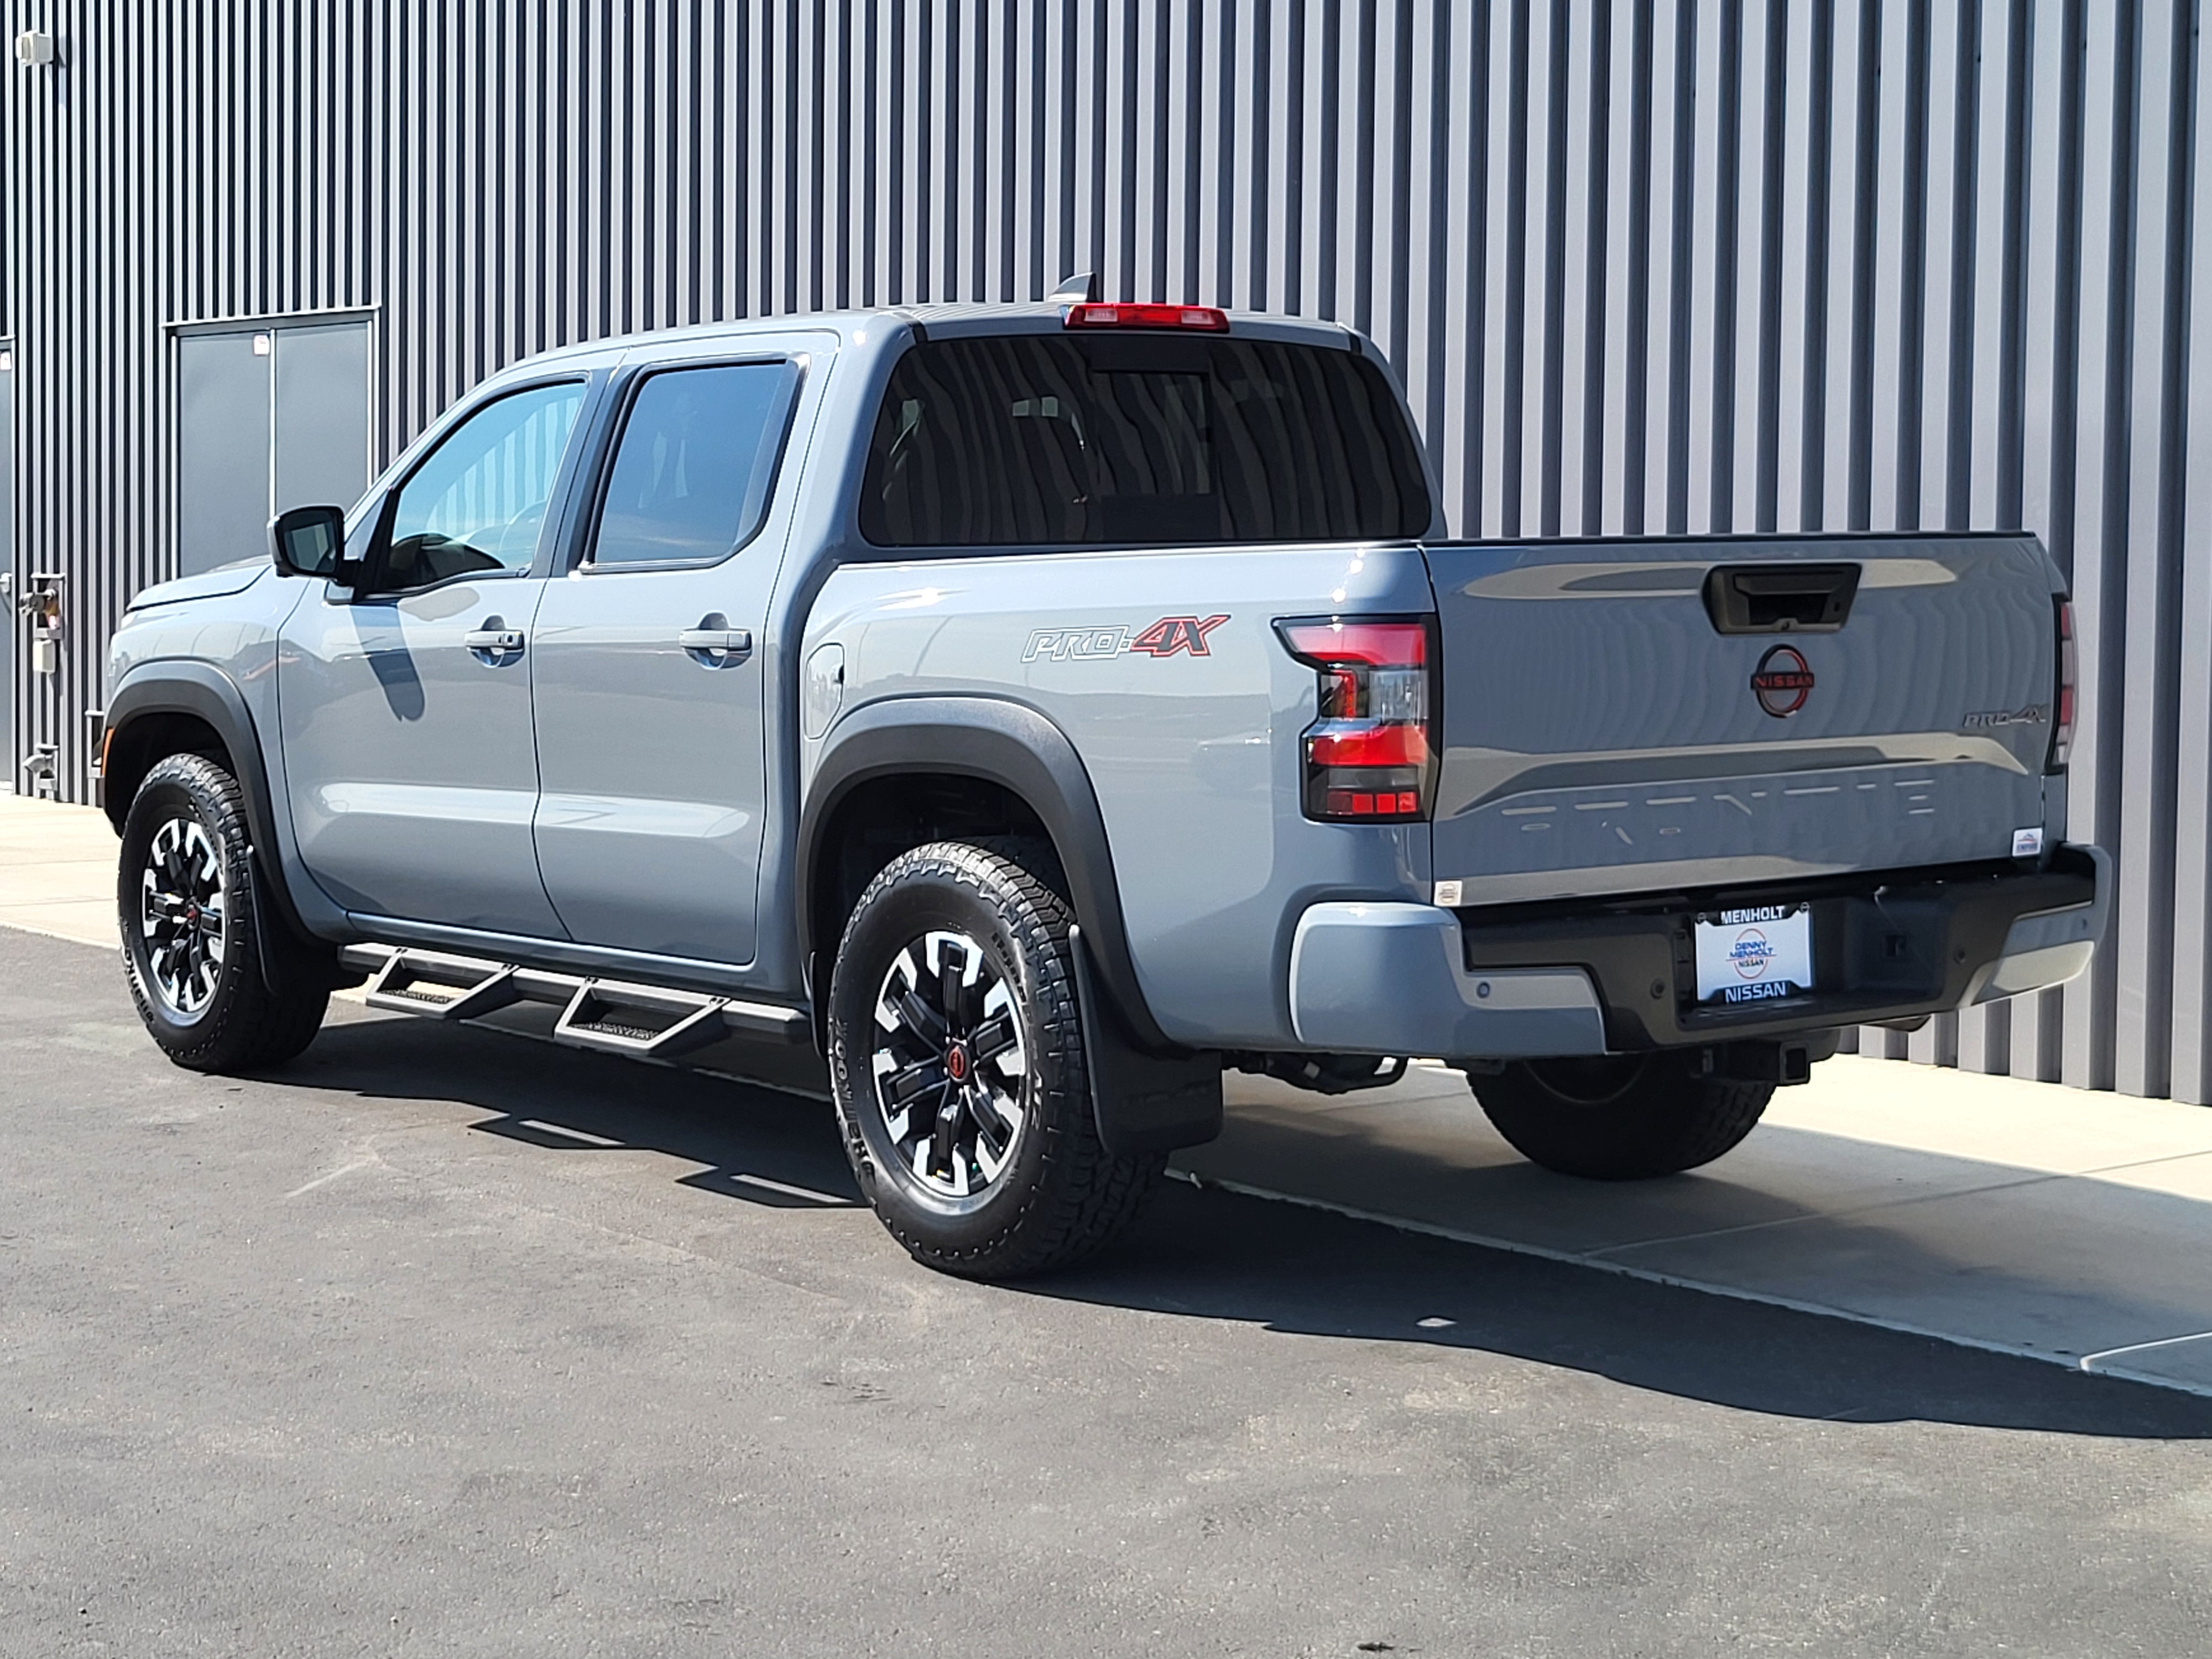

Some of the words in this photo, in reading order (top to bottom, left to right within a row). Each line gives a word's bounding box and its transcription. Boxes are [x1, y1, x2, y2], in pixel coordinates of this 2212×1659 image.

[1020, 614, 1232, 662] PRO-4X
[1756, 675, 1813, 687] NISSAN
[1720, 905, 1785, 925] MENHOLT
[1735, 941, 1767, 951] DENNY
[1729, 947, 1773, 958] MENHOLT
[1738, 958, 1764, 968] NISSAN
[1725, 982, 1786, 1003] NISSAN
